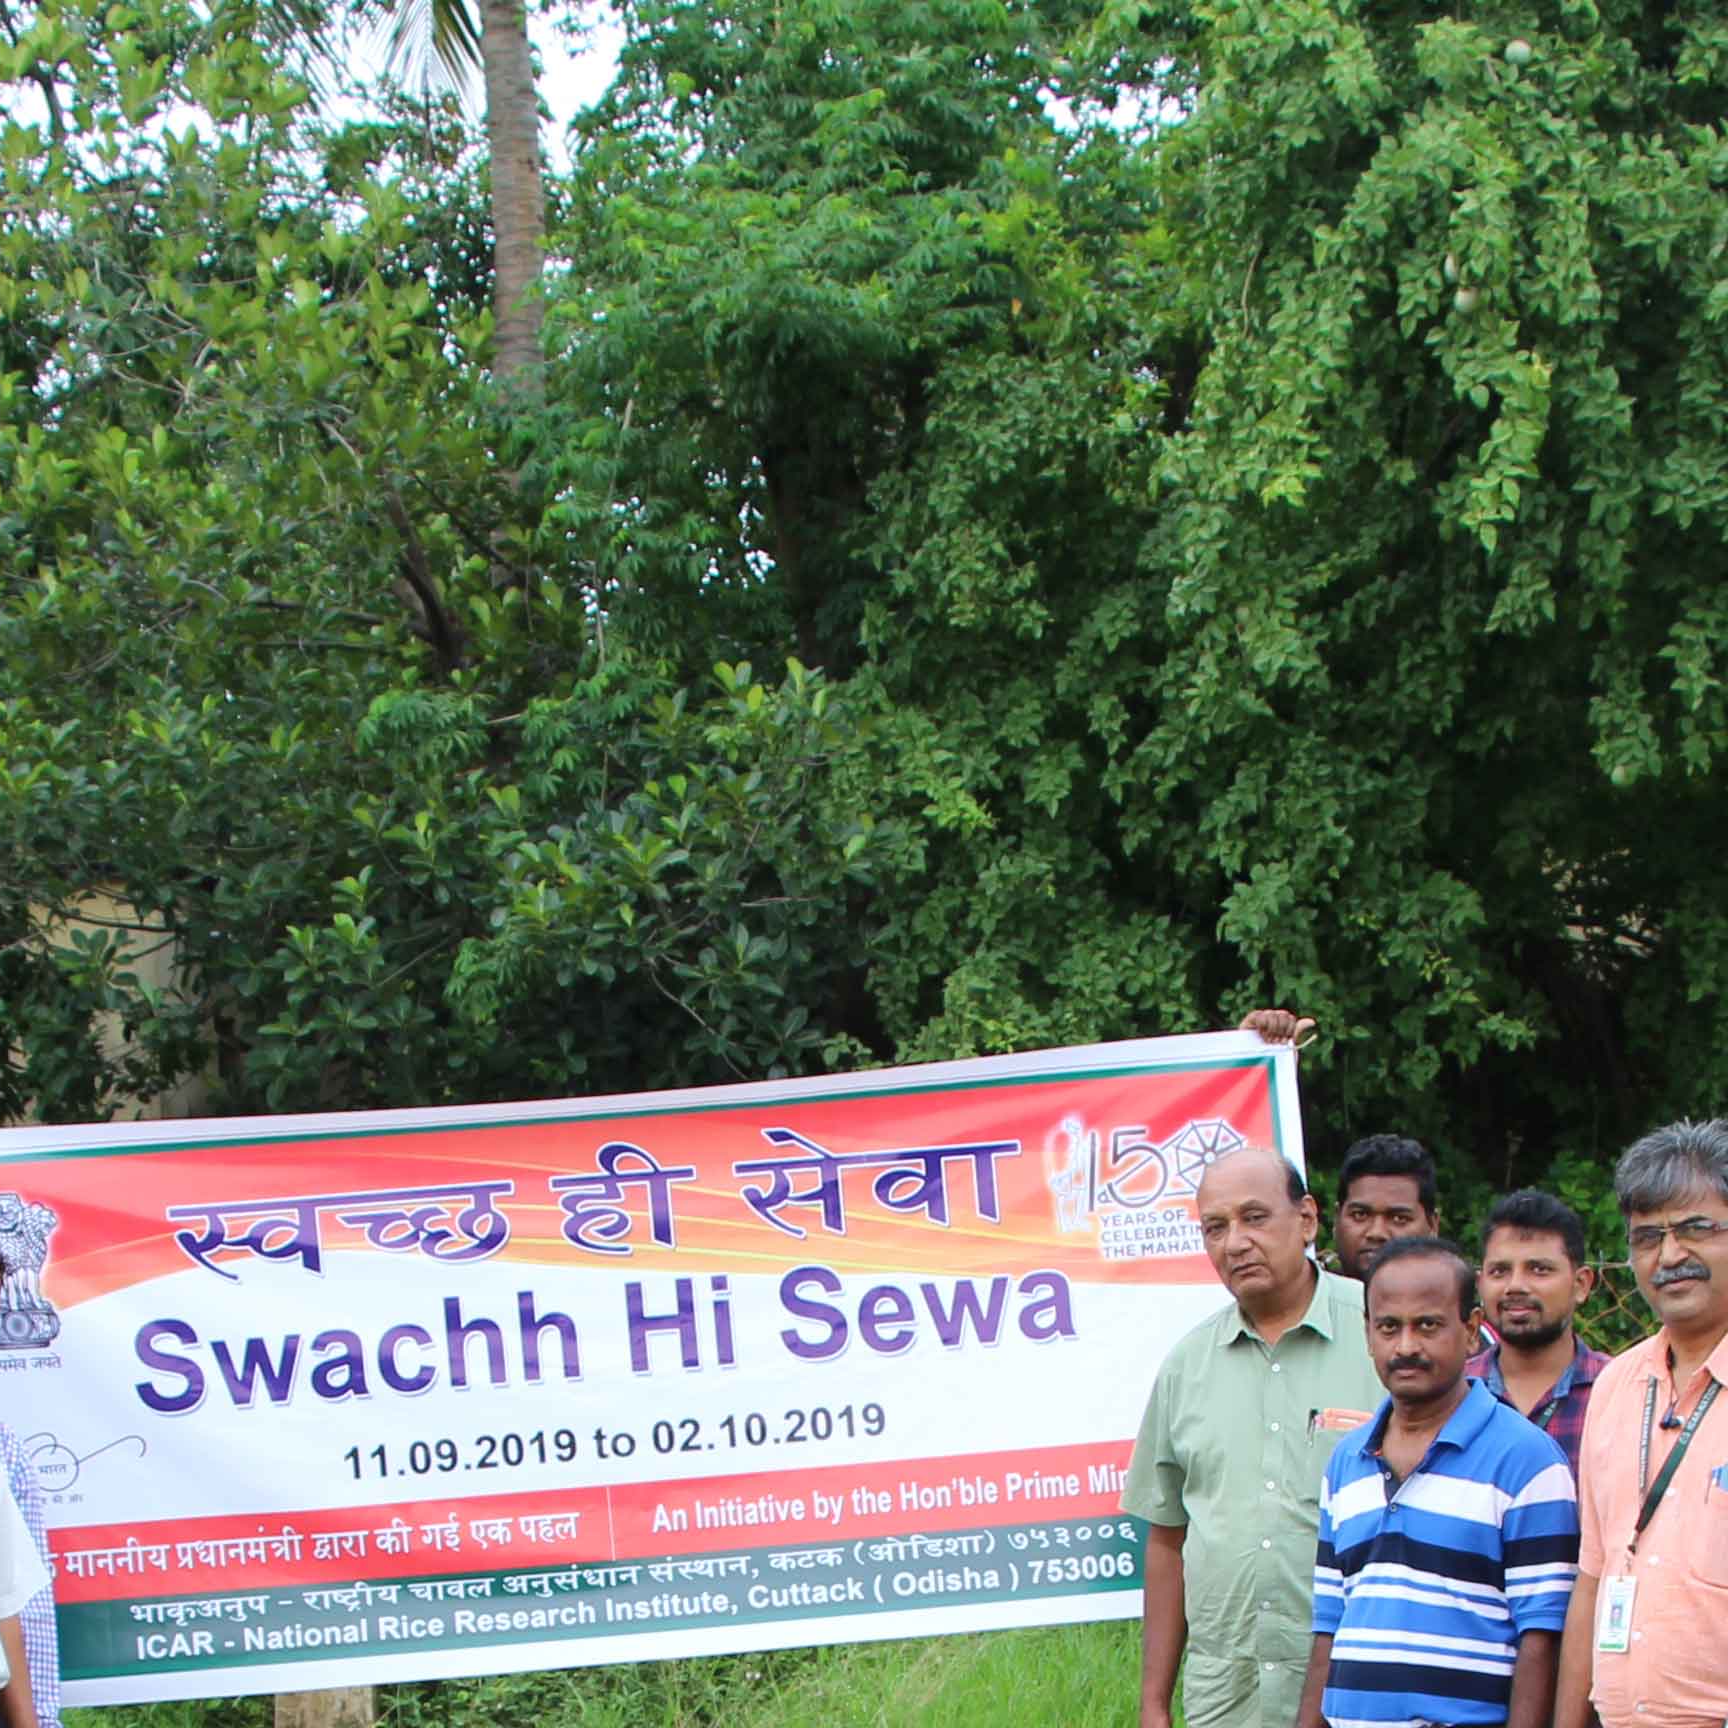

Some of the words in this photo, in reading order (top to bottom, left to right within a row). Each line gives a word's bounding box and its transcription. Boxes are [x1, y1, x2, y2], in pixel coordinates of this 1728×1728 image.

[169, 1182, 513, 1280] स्वच्छ
[550, 1142, 696, 1254] ही
[733, 1128, 1020, 1237] सेवा
[1101, 1211, 1157, 1227] YEARS
[1163, 1209, 1186, 1222] OF
[1103, 1244, 1136, 1259] THE
[134, 1290, 581, 1414] Swachh
[624, 1275, 736, 1374] Hi
[779, 1265, 1077, 1360] Sewa
[344, 1429, 577, 1479] 11.09.2019
[594, 1427, 636, 1459] to
[652, 1403, 886, 1454] 02.10.2019
[652, 1503, 689, 1534] An
[696, 1493, 806, 1529] Initiative
[813, 1489, 844, 1526] by
[852, 1486, 892, 1516] the
[900, 1476, 999, 1512] Hon'ble
[1005, 1470, 1080, 1501] Prime
[64, 1537, 170, 1577] माननीय
[176, 1525, 304, 1570] प्रधानमंत्री
[312, 1530, 368, 1560] द्वारा
[375, 1518, 412, 1554] की
[421, 1512, 461, 1551] गई
[471, 1517, 513, 1549] एक
[519, 1512, 580, 1543] पहल
[130, 1595, 270, 1627] भाकृअनुप
[302, 1581, 401, 1612] राष्ट्रीय
[408, 1577, 495, 1602] चावल
[502, 1563, 642, 1598] अनुसंधान
[648, 1556, 761, 1583] संस्थान,
[768, 1547, 845, 1573] कटक
[853, 1529, 996, 1566] (ओडिशा)
[137, 1630, 216, 1660] ICAR
[244, 1617, 368, 1652] National
[378, 1615, 445, 1641] Rice
[455, 1600, 596, 1635] Research
[606, 1590, 739, 1623] Institute,
[748, 1577, 866, 1609] Cuttack
[1027, 1551, 1136, 1585] 753006
